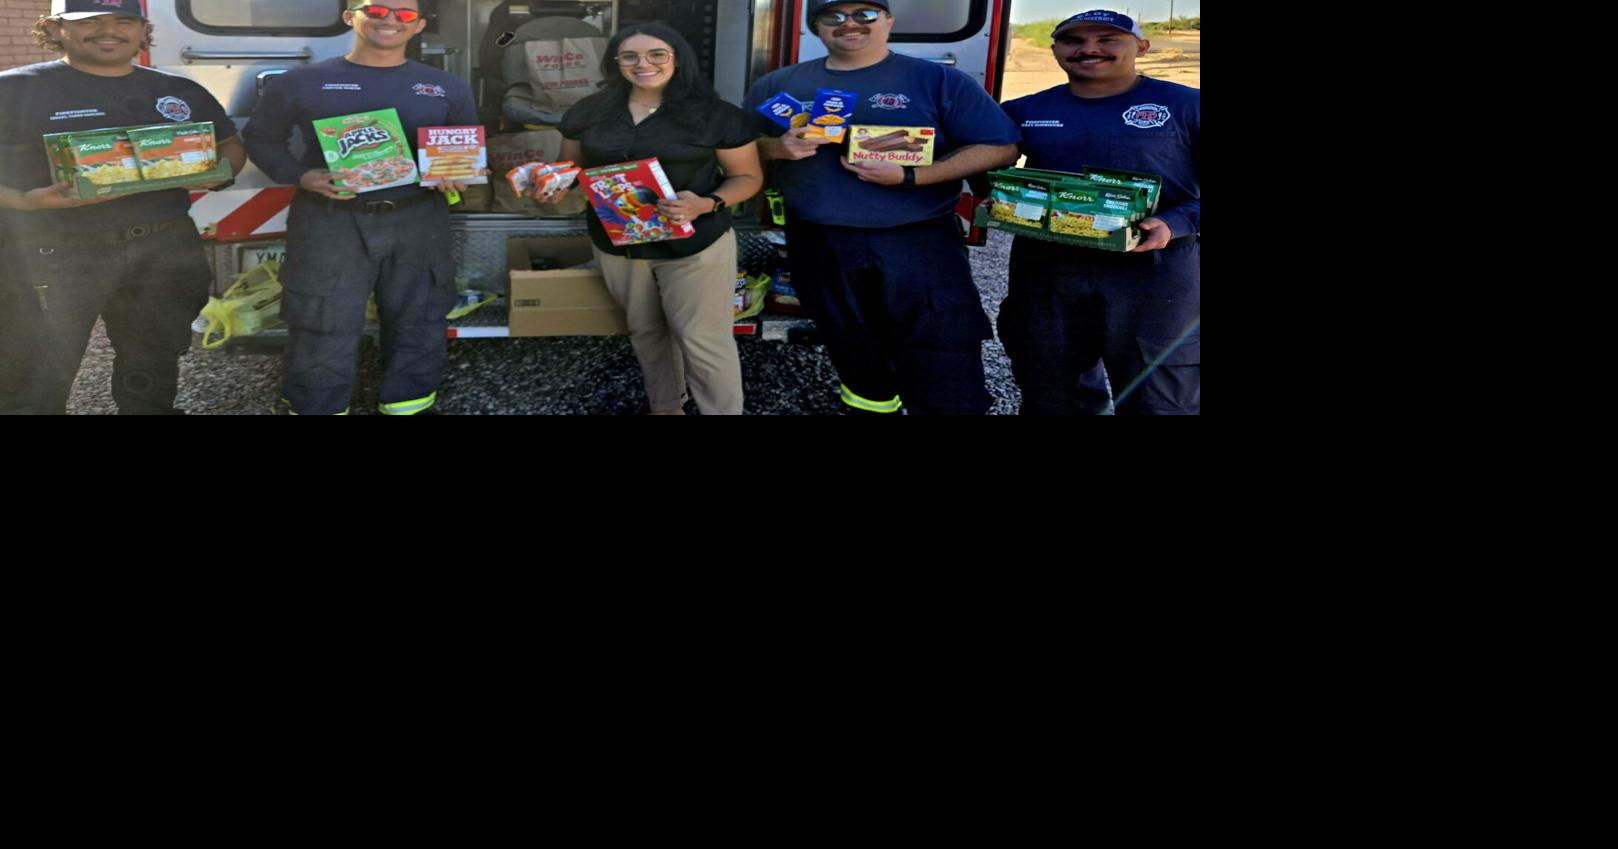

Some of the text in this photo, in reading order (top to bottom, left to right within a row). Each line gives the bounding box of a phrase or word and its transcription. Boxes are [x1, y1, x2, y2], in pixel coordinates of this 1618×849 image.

[429, 128, 477, 136] HUNGRY
[140, 138, 173, 147] Knorr
[339, 130, 389, 156] JACKS
[426, 134, 479, 145] JACK
[79, 143, 113, 152] Knorr
[852, 151, 924, 163] Nutty Buddy
[1089, 173, 1122, 185] Knorr
[993, 181, 1020, 191] Knorr
[1058, 191, 1094, 202] Knorr
